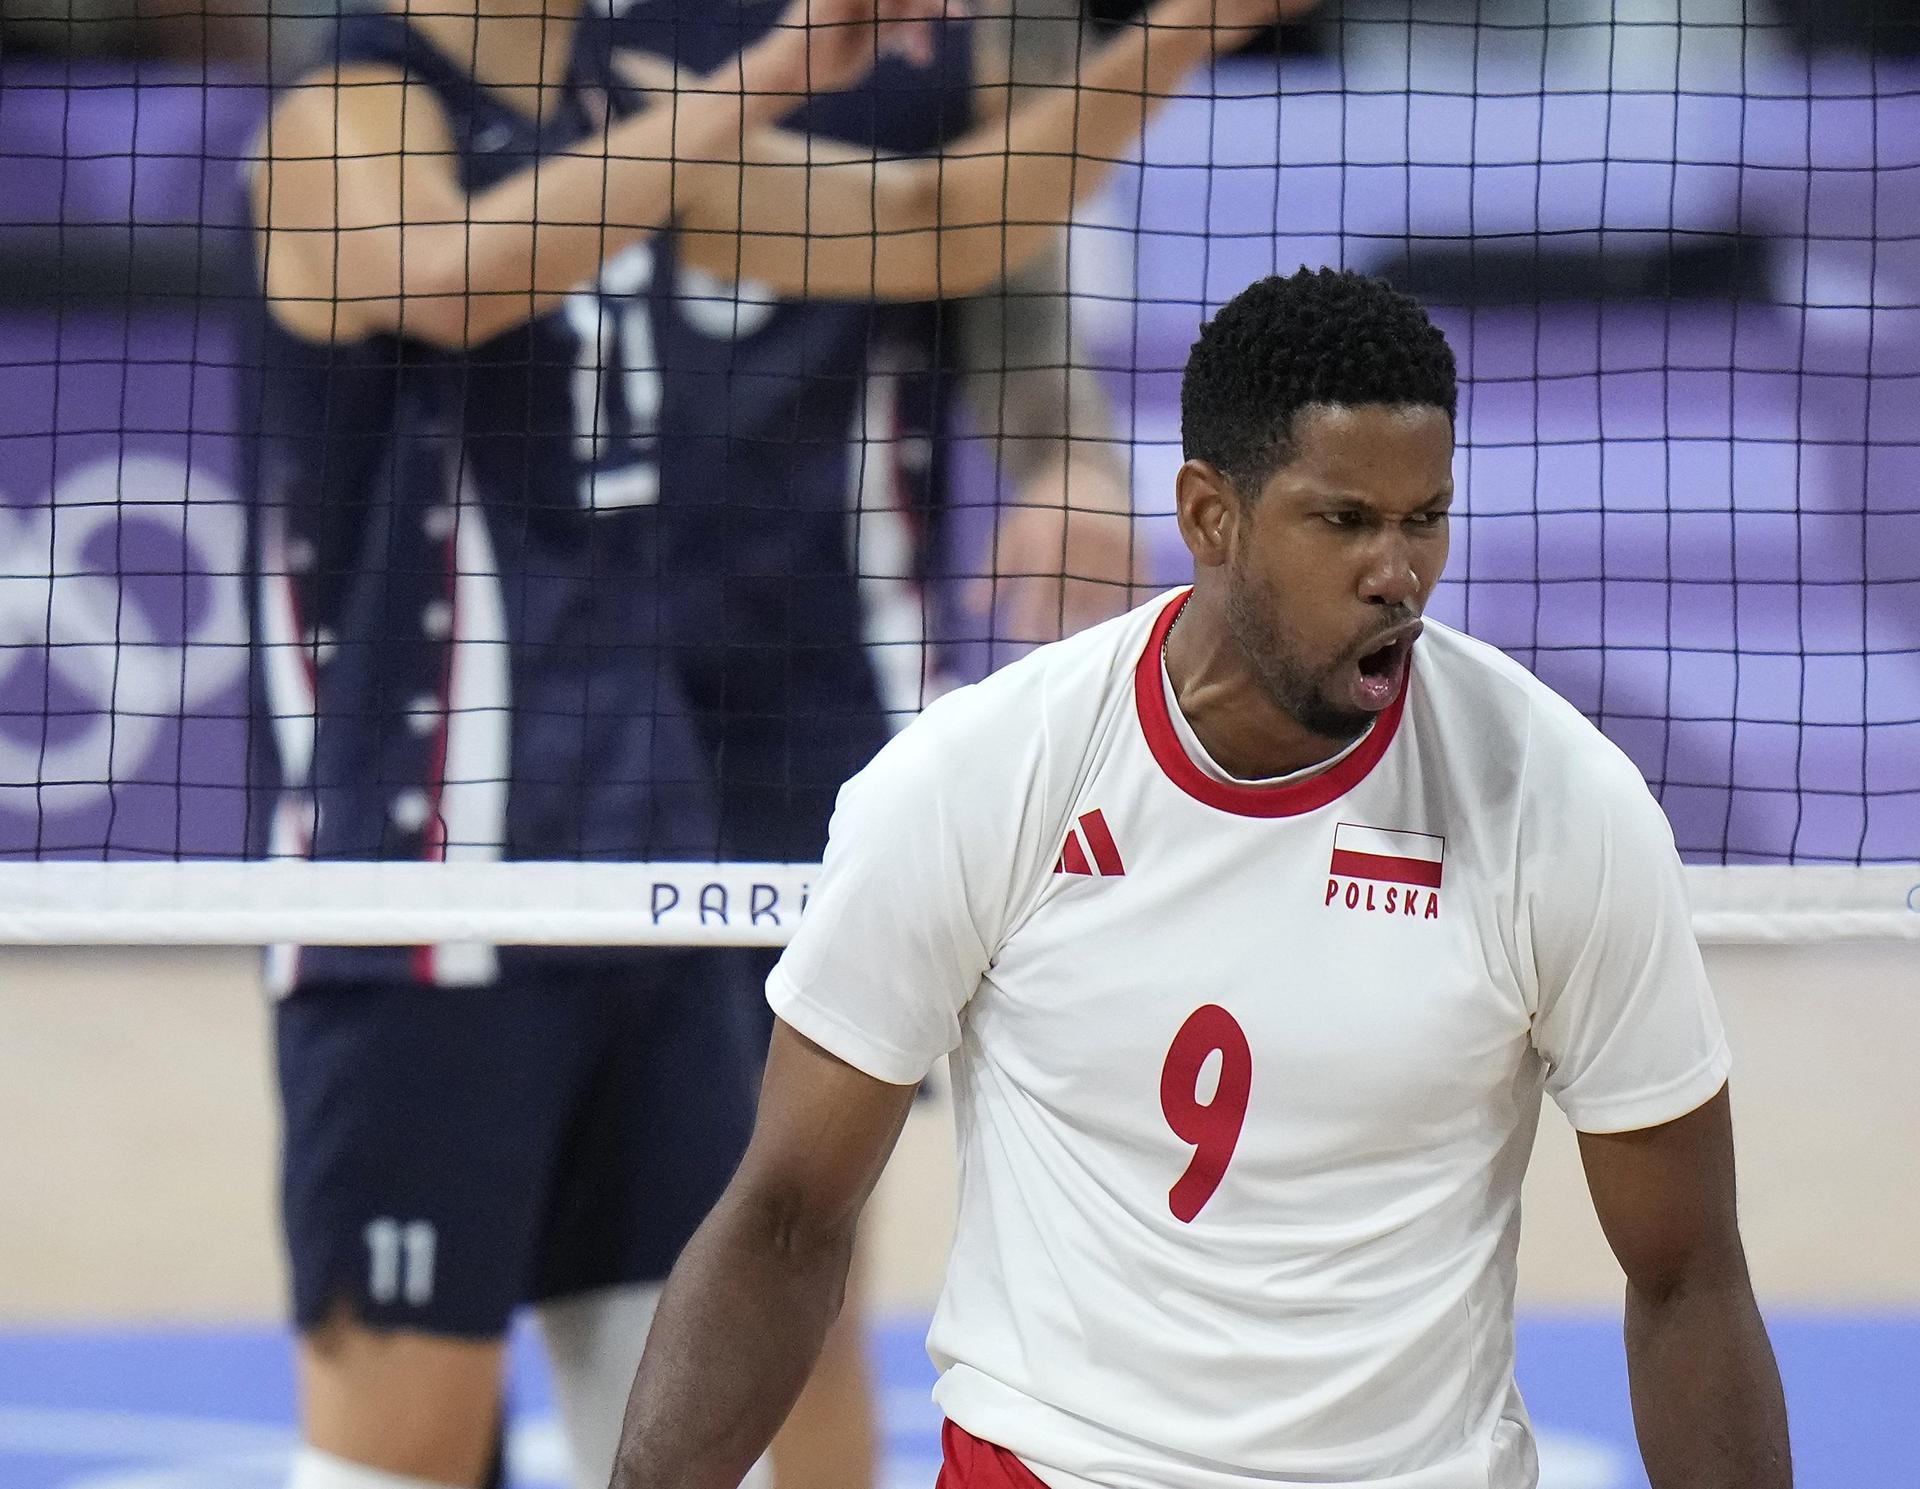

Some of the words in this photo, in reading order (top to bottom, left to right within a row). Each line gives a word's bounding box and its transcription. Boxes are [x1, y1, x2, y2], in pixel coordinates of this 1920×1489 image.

[1325, 879, 1439, 920] POLSKA
[1160, 1004, 1252, 1223] 9
[364, 1217, 438, 1305] 11
